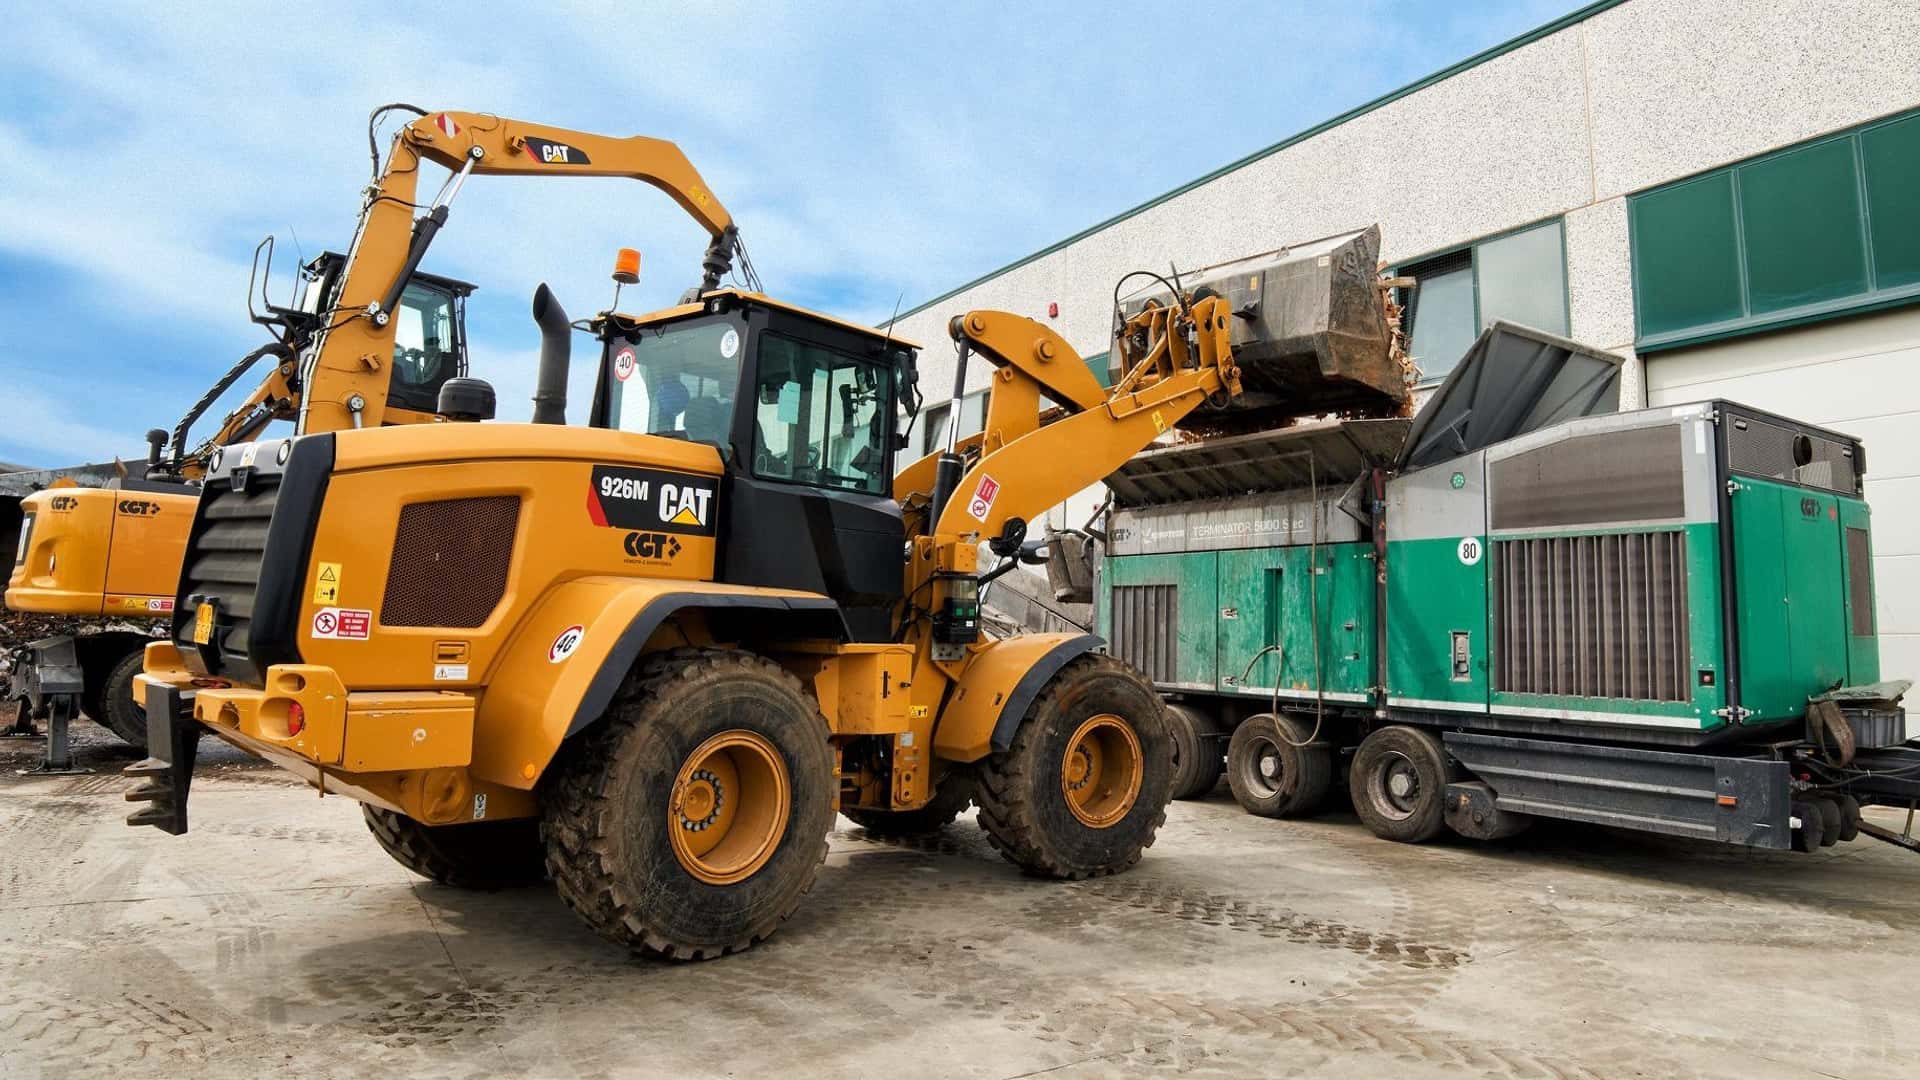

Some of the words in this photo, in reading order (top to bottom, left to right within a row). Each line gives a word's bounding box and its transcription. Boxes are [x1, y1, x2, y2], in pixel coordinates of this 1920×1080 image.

[542, 144, 569, 163] CAT
[601, 476, 649, 501] 926M
[118, 500, 151, 515] CGT
[659, 483, 712, 527] CAT
[1192, 521, 1251, 537] TERMINATOR
[623, 531, 668, 559] CGT
[1463, 543, 1477, 559] 80
